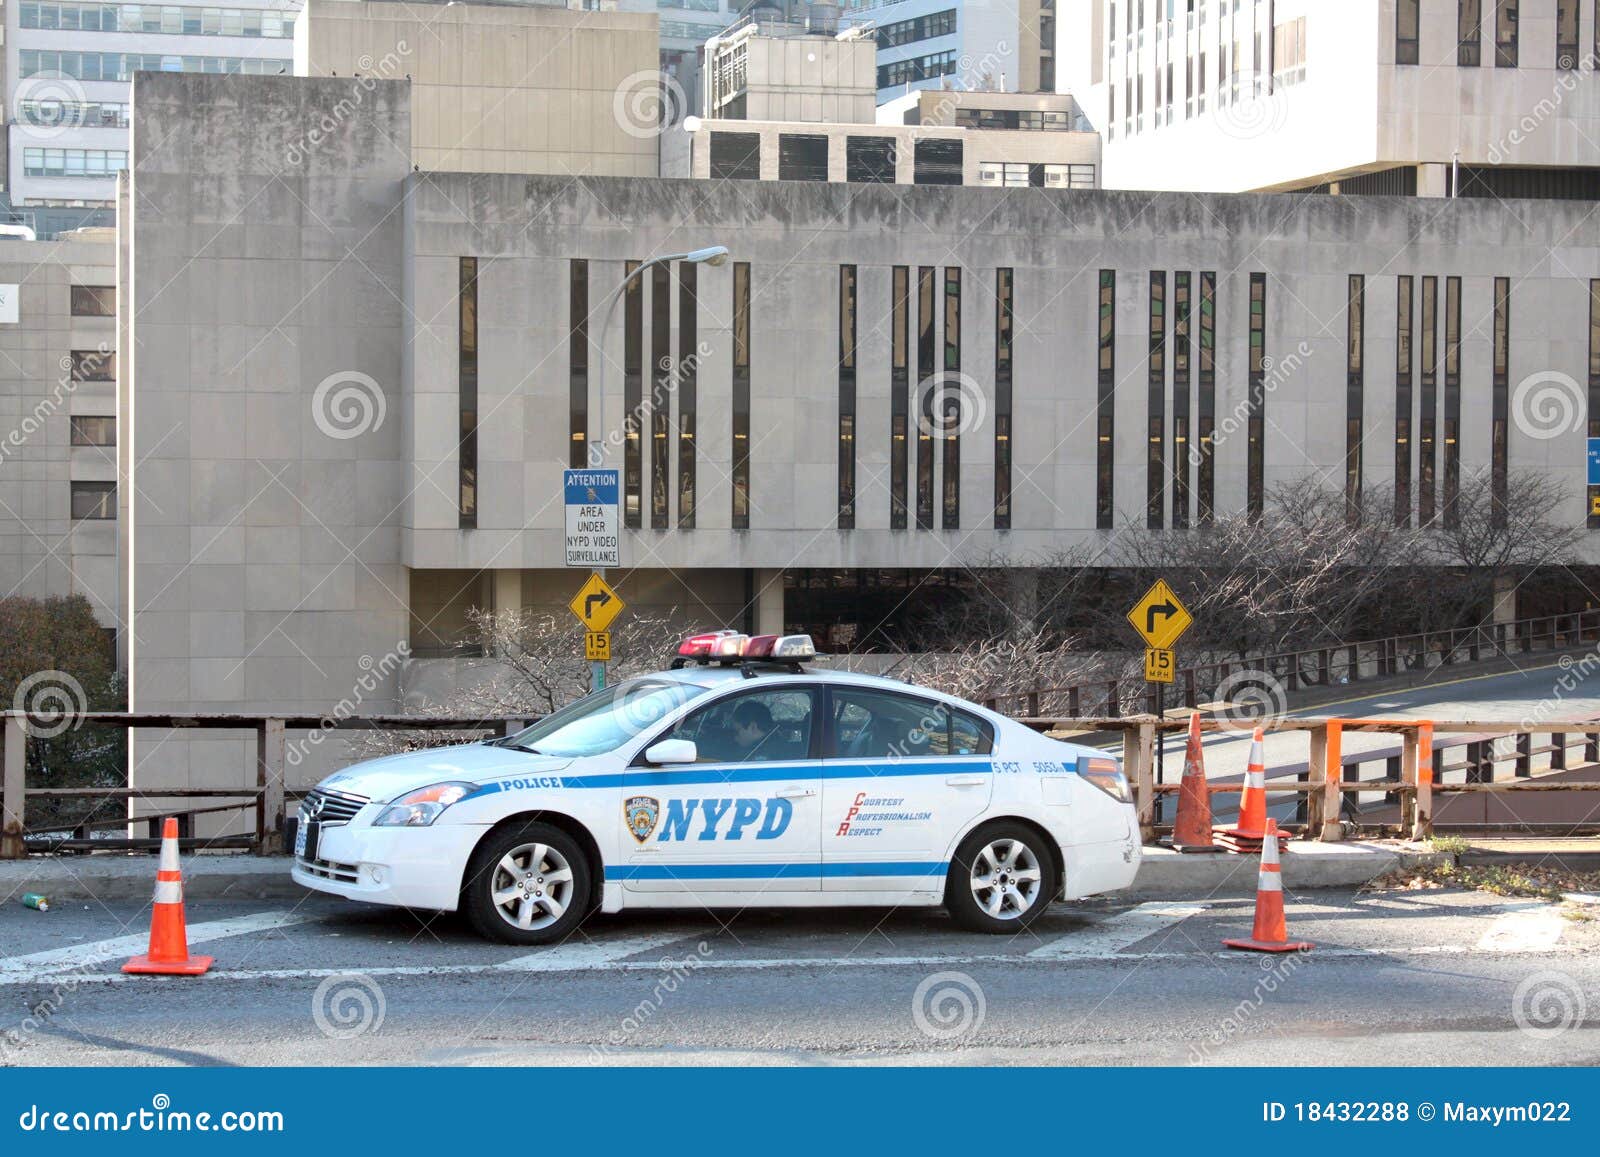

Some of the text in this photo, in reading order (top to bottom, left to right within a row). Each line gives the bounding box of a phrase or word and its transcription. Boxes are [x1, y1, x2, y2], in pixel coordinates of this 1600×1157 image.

[567, 474, 616, 486] ATTENTION
[580, 506, 604, 517] AREA
[577, 521, 606, 532] UNDER
[567, 536, 617, 547] NYPD VIDEO
[568, 550, 617, 562] SURVEILLANCE
[588, 634, 607, 649] 15
[1149, 651, 1170, 669] 15
[1002, 761, 1022, 774] PCT
[501, 776, 561, 791] POLICE
[657, 797, 793, 842] NYPD
